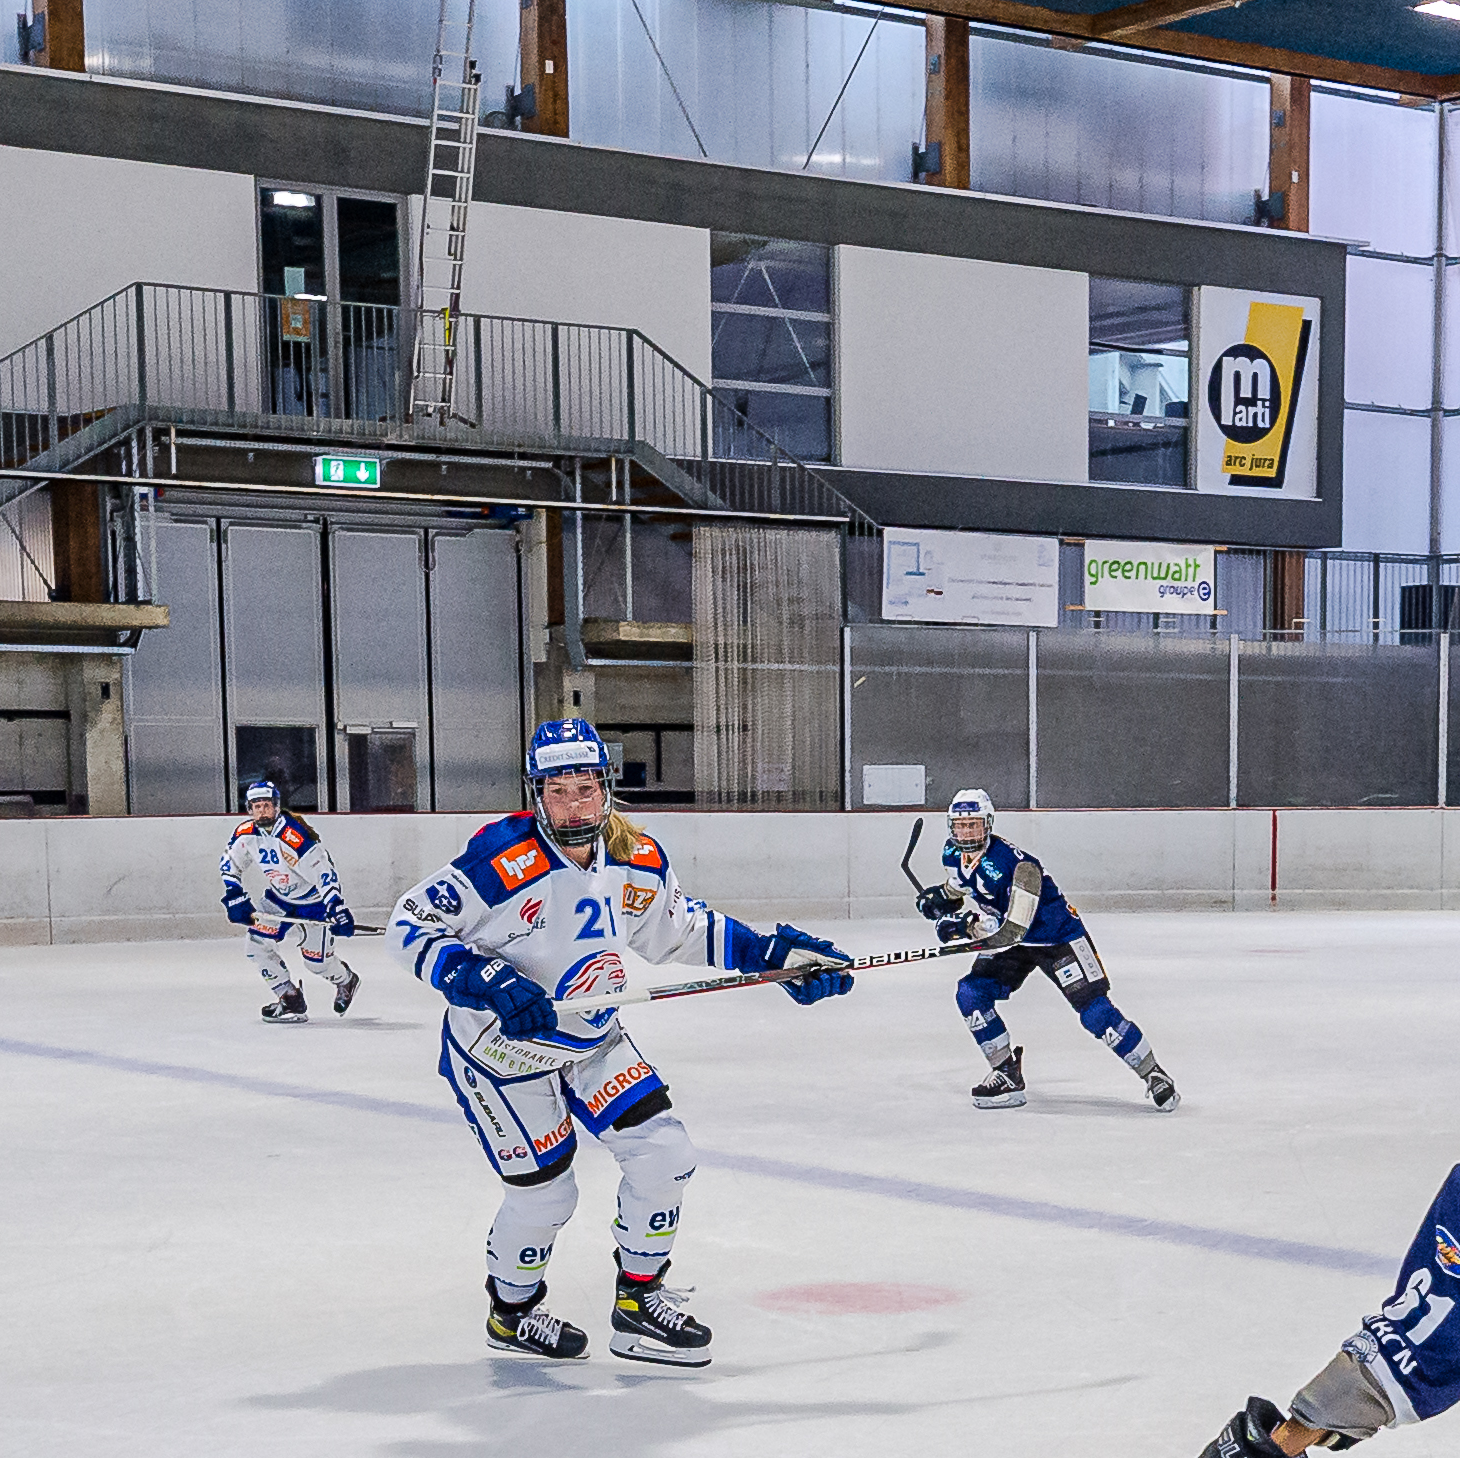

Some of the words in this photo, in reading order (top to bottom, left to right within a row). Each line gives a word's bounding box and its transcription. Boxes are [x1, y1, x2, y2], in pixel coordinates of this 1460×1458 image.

[1226, 455, 1246, 468] arc
[1249, 454, 1275, 471] jura
[1088, 557, 1201, 585] greenwatt
[1158, 583, 1196, 600] groupe
[258, 848, 280, 865] 28
[500, 849, 538, 880] hrs
[574, 896, 616, 942] 21
[853, 946, 941, 968] BAUER
[490, 1034, 558, 1067] RISTORANTE
[587, 1060, 652, 1116] MIGROS
[474, 1091, 507, 1138] SUBARU
